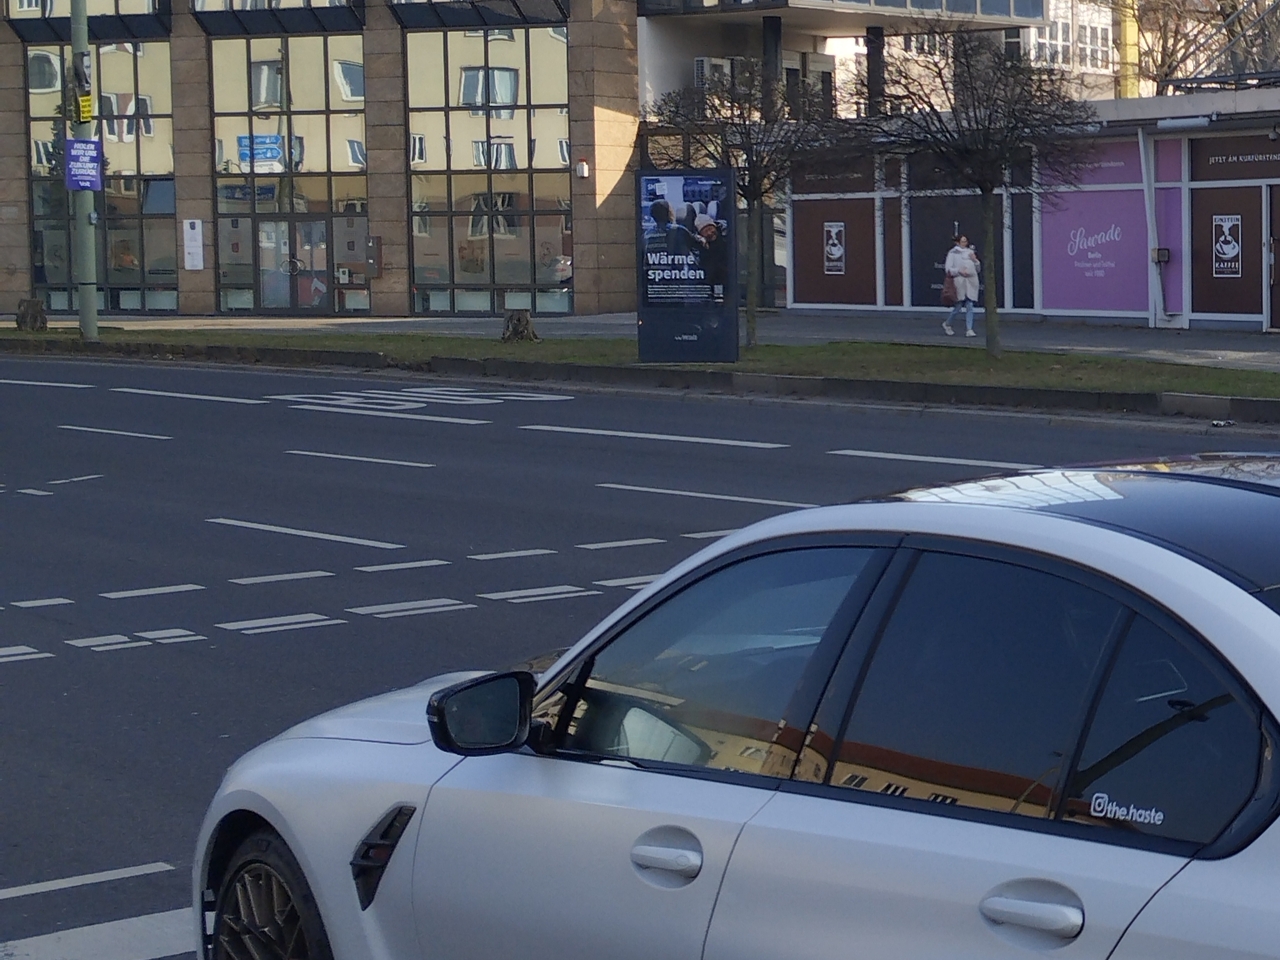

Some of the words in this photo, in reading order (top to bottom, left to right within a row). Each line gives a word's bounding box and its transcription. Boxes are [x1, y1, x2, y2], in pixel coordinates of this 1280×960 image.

[1067, 224, 1122, 256] Sawade
[647, 252, 695, 264] Wärme
[647, 266, 704, 281] spenden
[262, 387, 575, 410] BUS
[1106, 801, 1164, 825] the.haste
